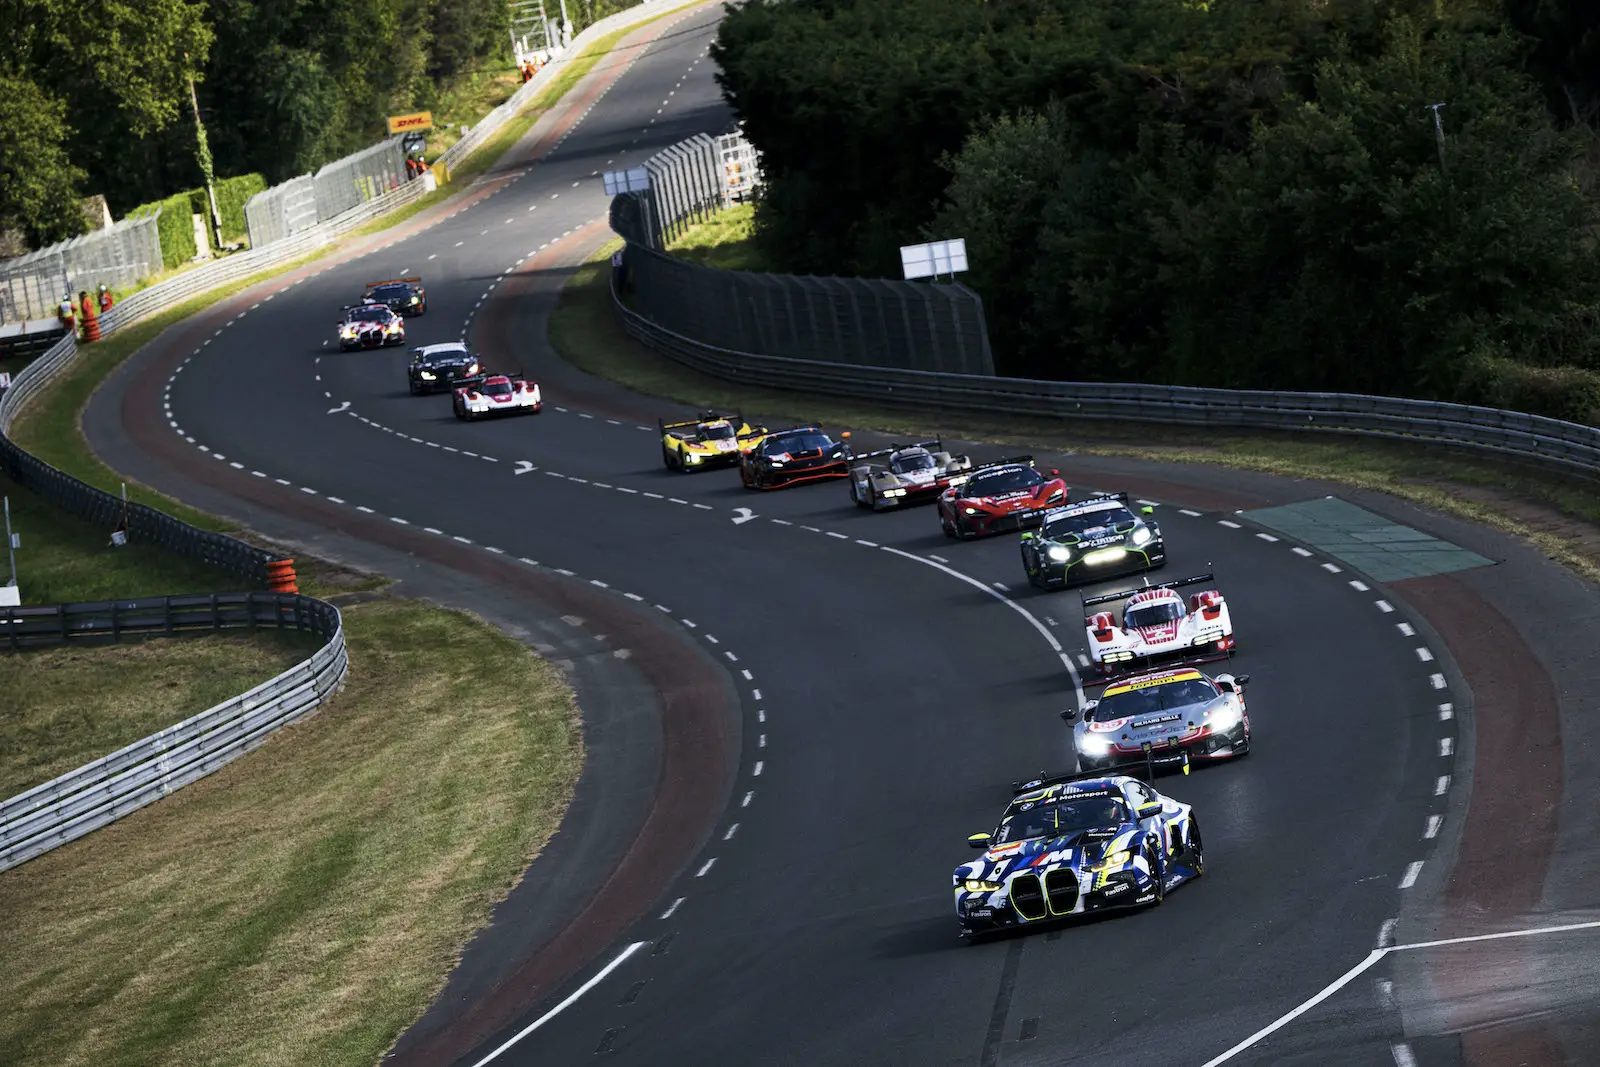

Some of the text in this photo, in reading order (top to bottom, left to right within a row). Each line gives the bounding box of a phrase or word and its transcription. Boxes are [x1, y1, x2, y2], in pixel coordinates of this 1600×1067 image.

[397, 117, 425, 128] DHL
[1130, 677, 1175, 690] Ferrari
[1060, 790, 1109, 801] Motorsport
